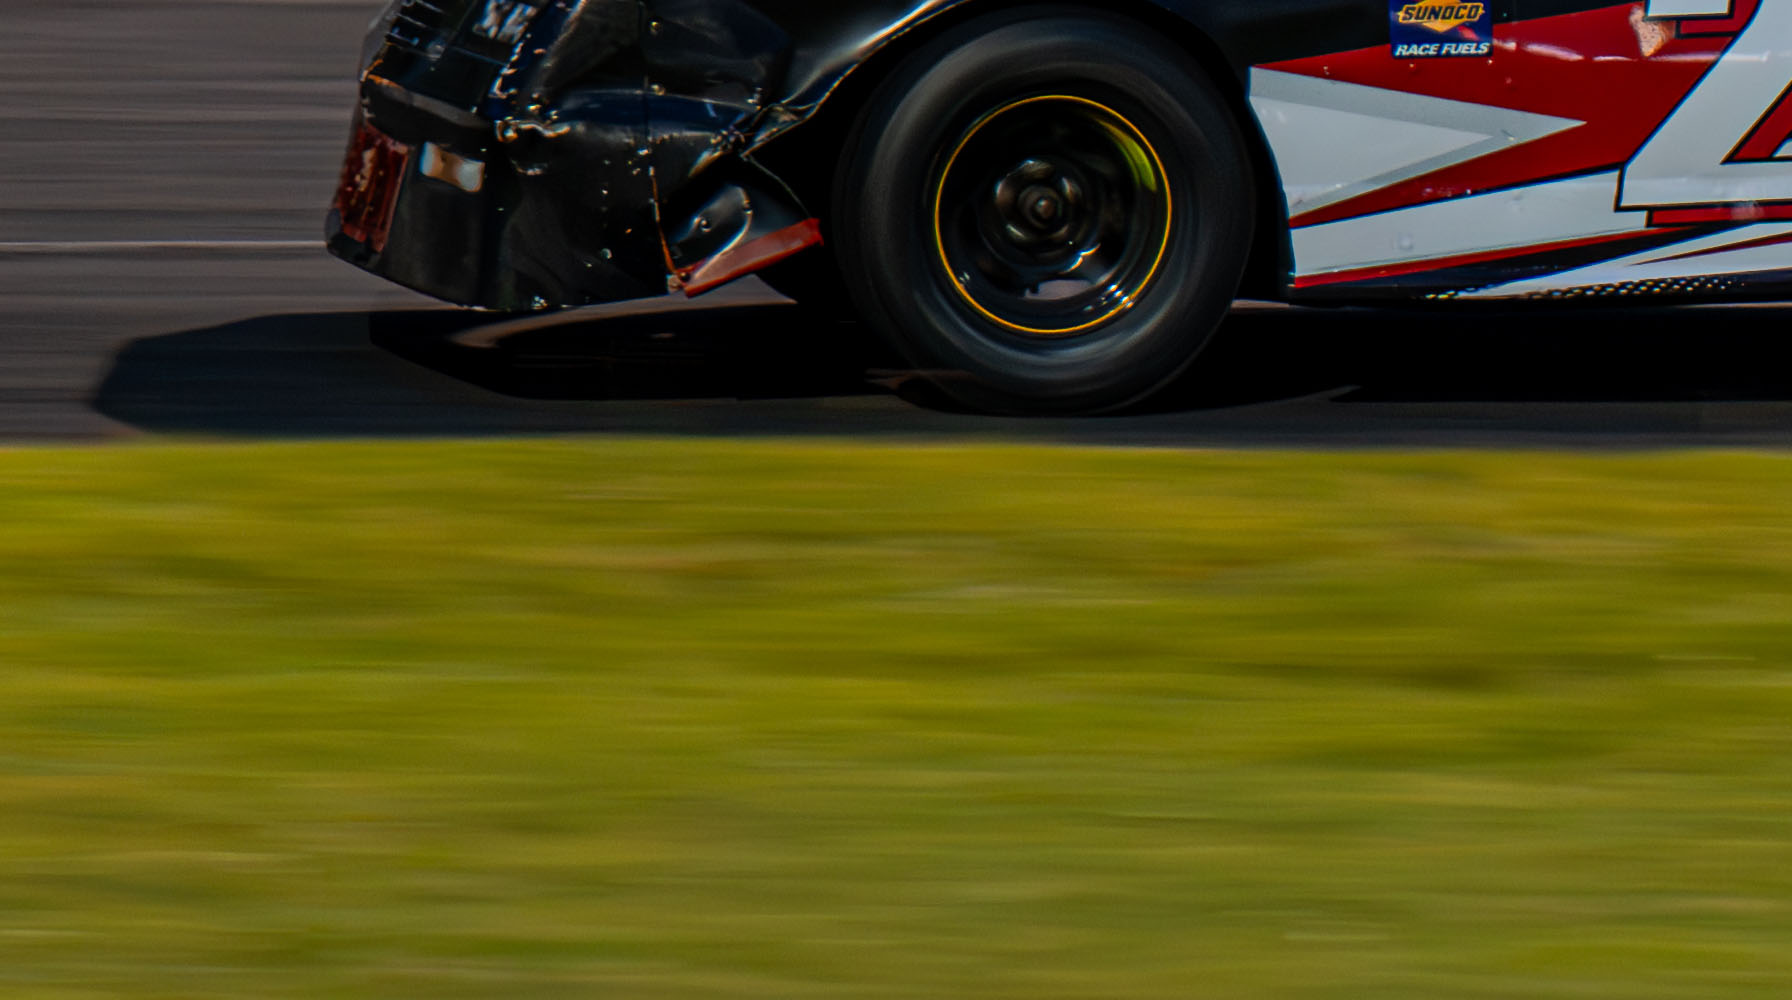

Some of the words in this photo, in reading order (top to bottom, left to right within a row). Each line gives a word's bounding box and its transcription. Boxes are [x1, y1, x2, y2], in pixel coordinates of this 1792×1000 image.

[1401, 4, 1480, 21] SUNOCO
[1394, 43, 1440, 56] RACE
[1440, 42, 1490, 55] FUELS
